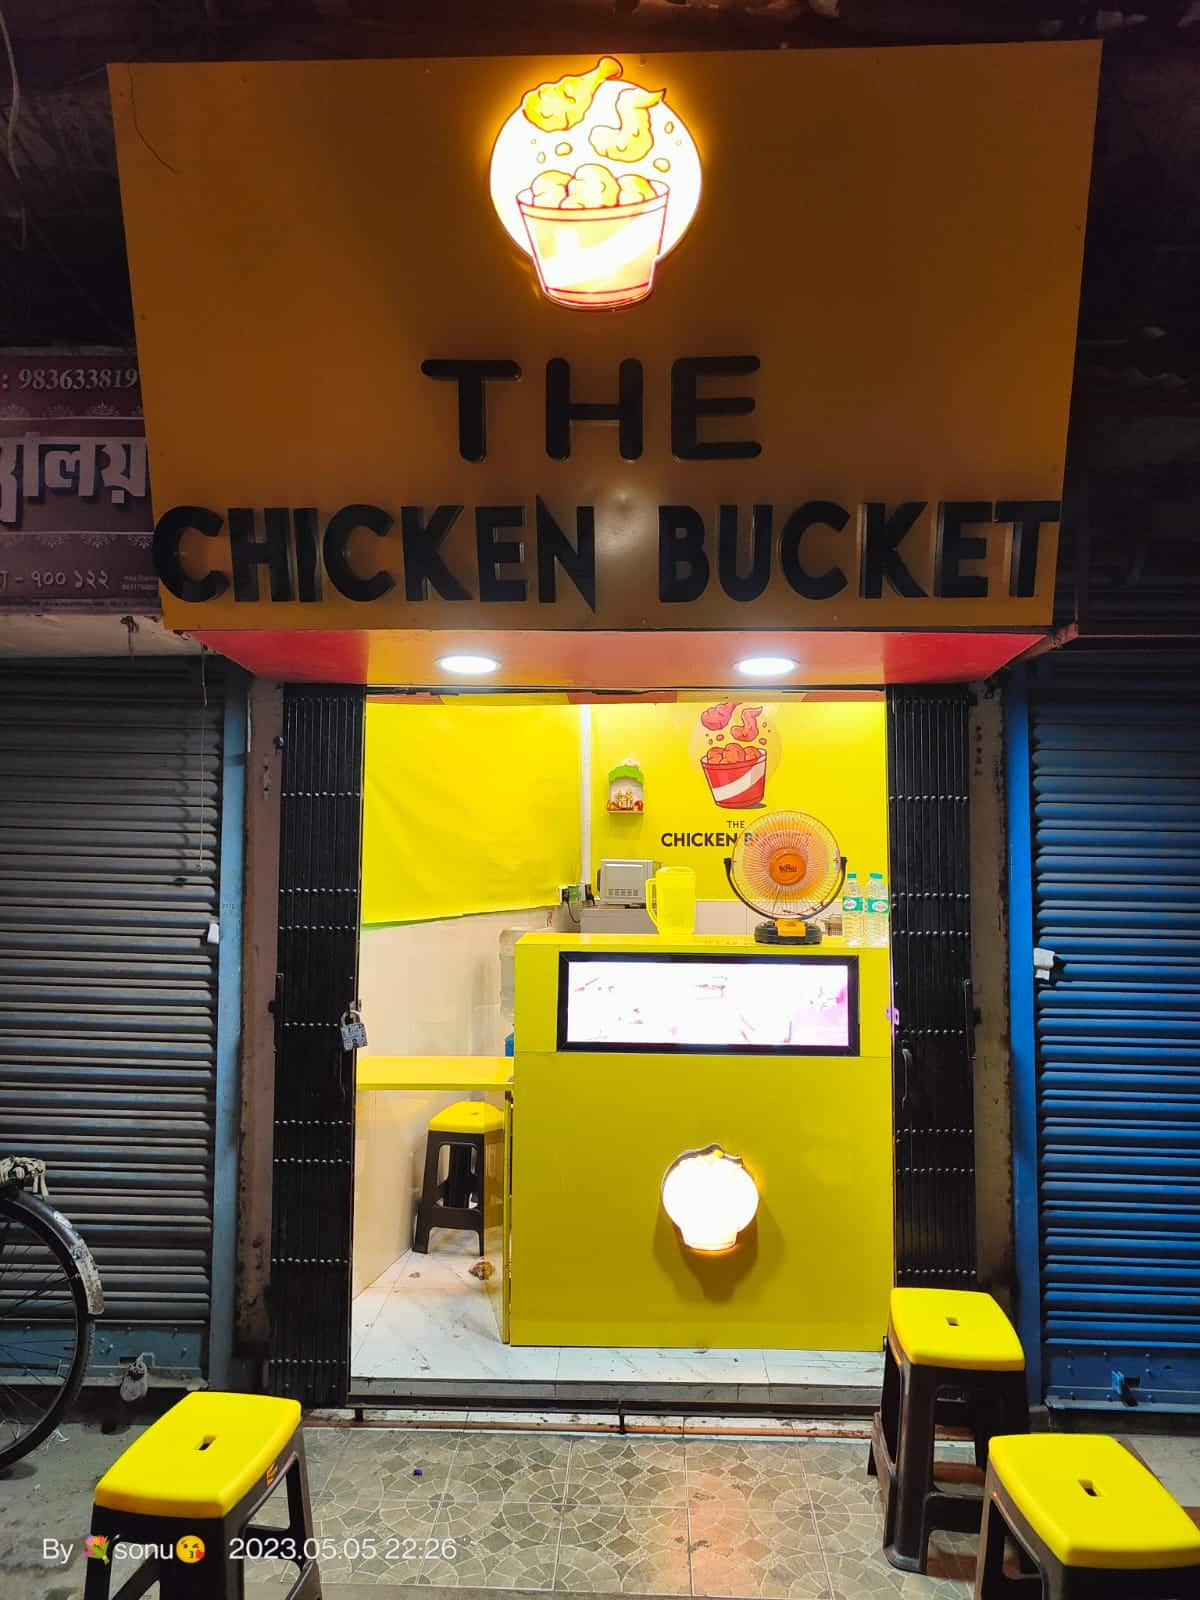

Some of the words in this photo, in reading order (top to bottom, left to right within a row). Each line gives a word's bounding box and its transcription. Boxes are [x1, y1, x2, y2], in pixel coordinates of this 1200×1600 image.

[18, 367, 138, 390] 983633819
[420, 355, 762, 462] THE
[152, 494, 597, 613] CHICKEN
[658, 500, 1063, 604] BUCKET
[726, 820, 745, 829] THE
[660, 832, 738, 848] CHICKEN
